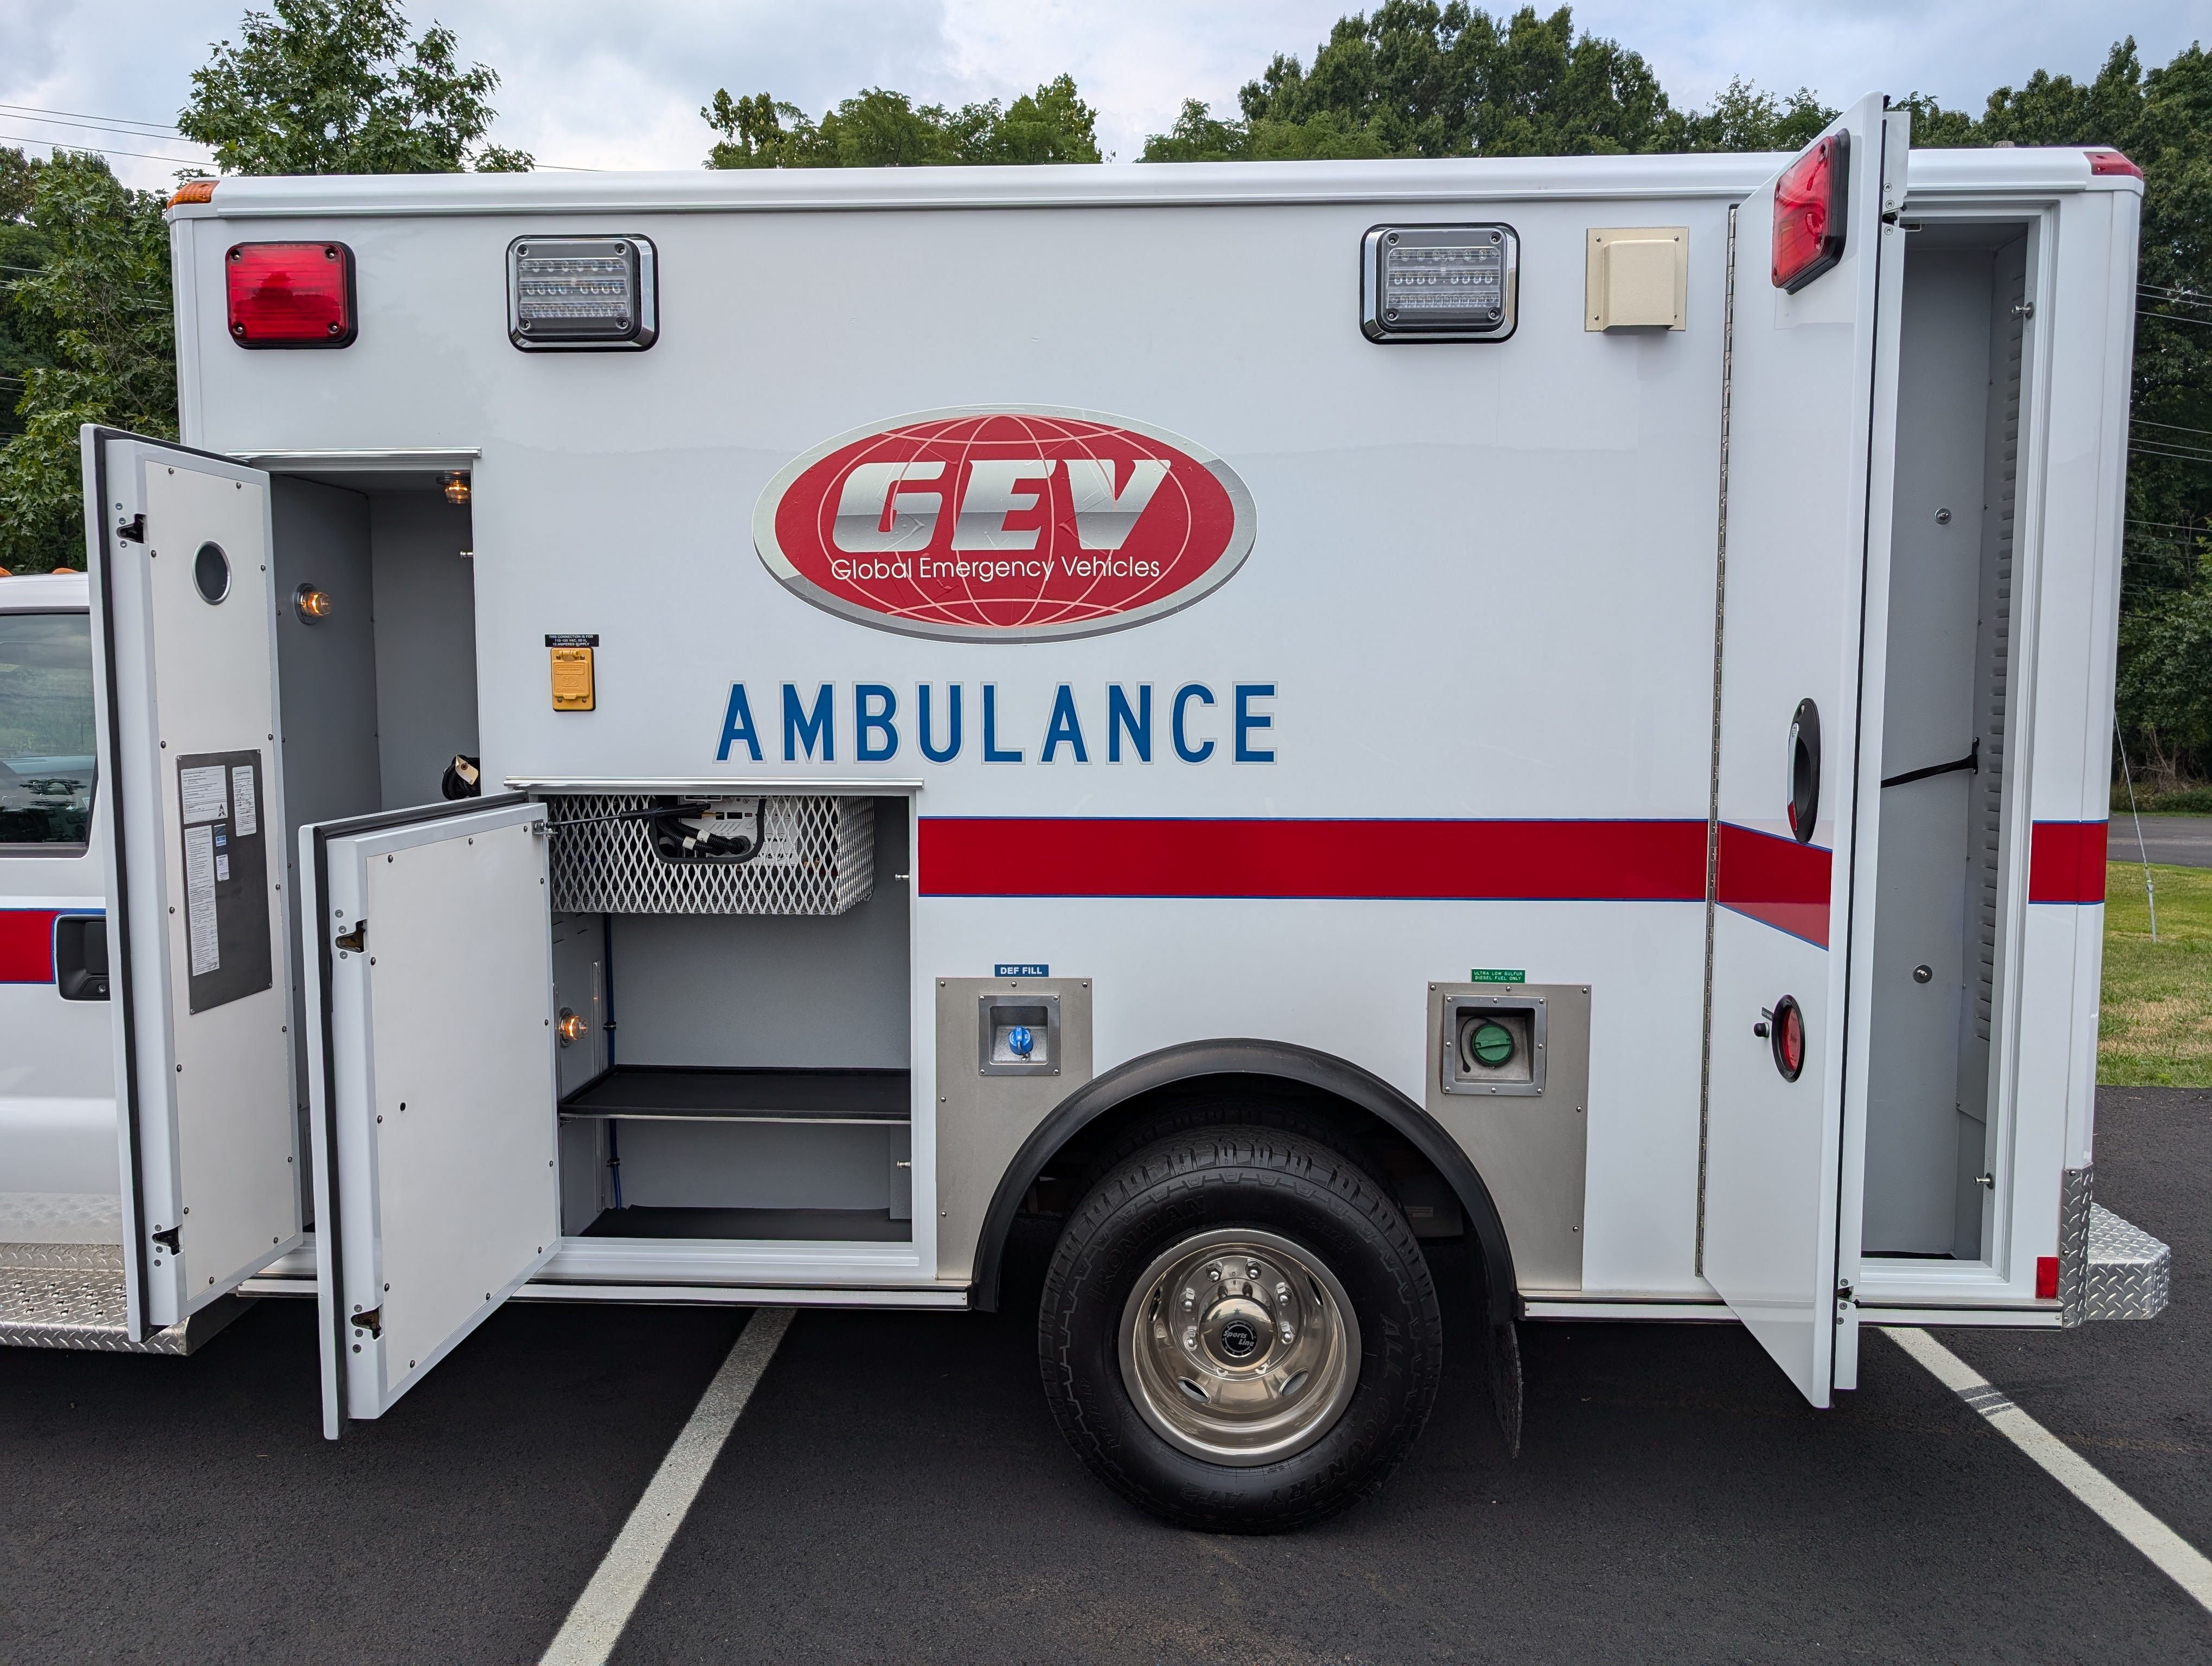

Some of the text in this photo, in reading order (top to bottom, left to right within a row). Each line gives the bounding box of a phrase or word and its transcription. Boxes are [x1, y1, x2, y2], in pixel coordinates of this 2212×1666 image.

[832, 458, 1171, 553] GEV
[831, 555, 1160, 582] Global Emergency Vehicles
[713, 681, 1277, 765] AMBULANCE
[1088, 1195, 1206, 1303] IRONMAN
[1223, 1330, 1248, 1338] Sports
[1238, 1338, 1255, 1347] Line
[1380, 1313, 1404, 1379] ALL
